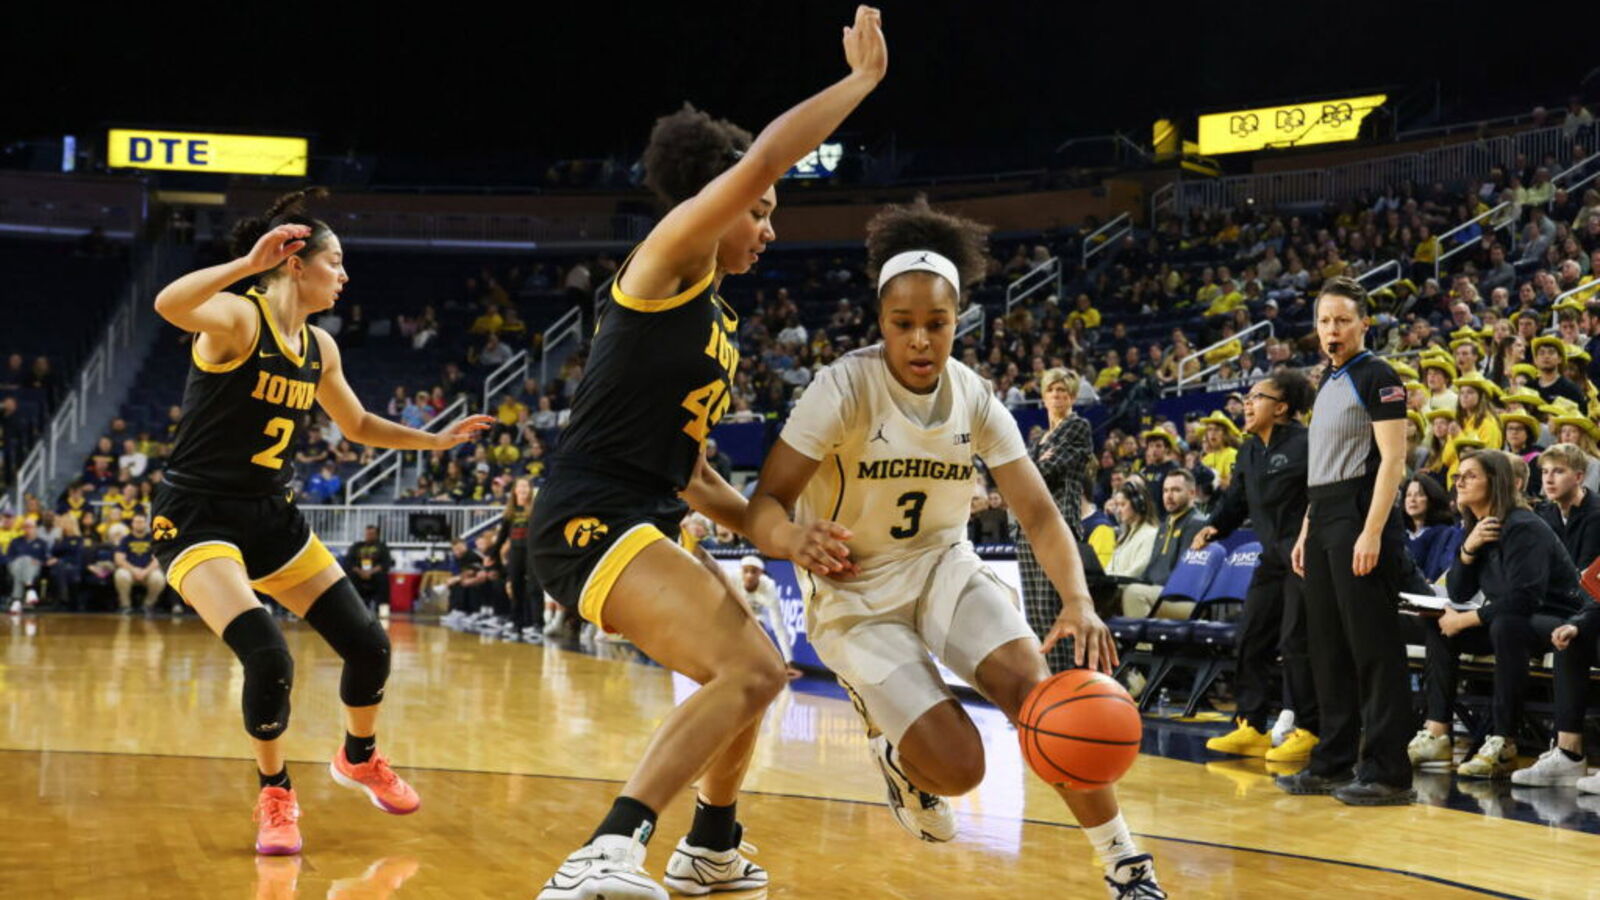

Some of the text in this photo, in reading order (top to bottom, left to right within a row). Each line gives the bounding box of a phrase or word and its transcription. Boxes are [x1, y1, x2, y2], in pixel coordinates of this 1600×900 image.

[128, 137, 208, 165] DTE
[251, 417, 294, 470] 2
[857, 459, 973, 480] MICHIGAN
[890, 491, 927, 540] 3
